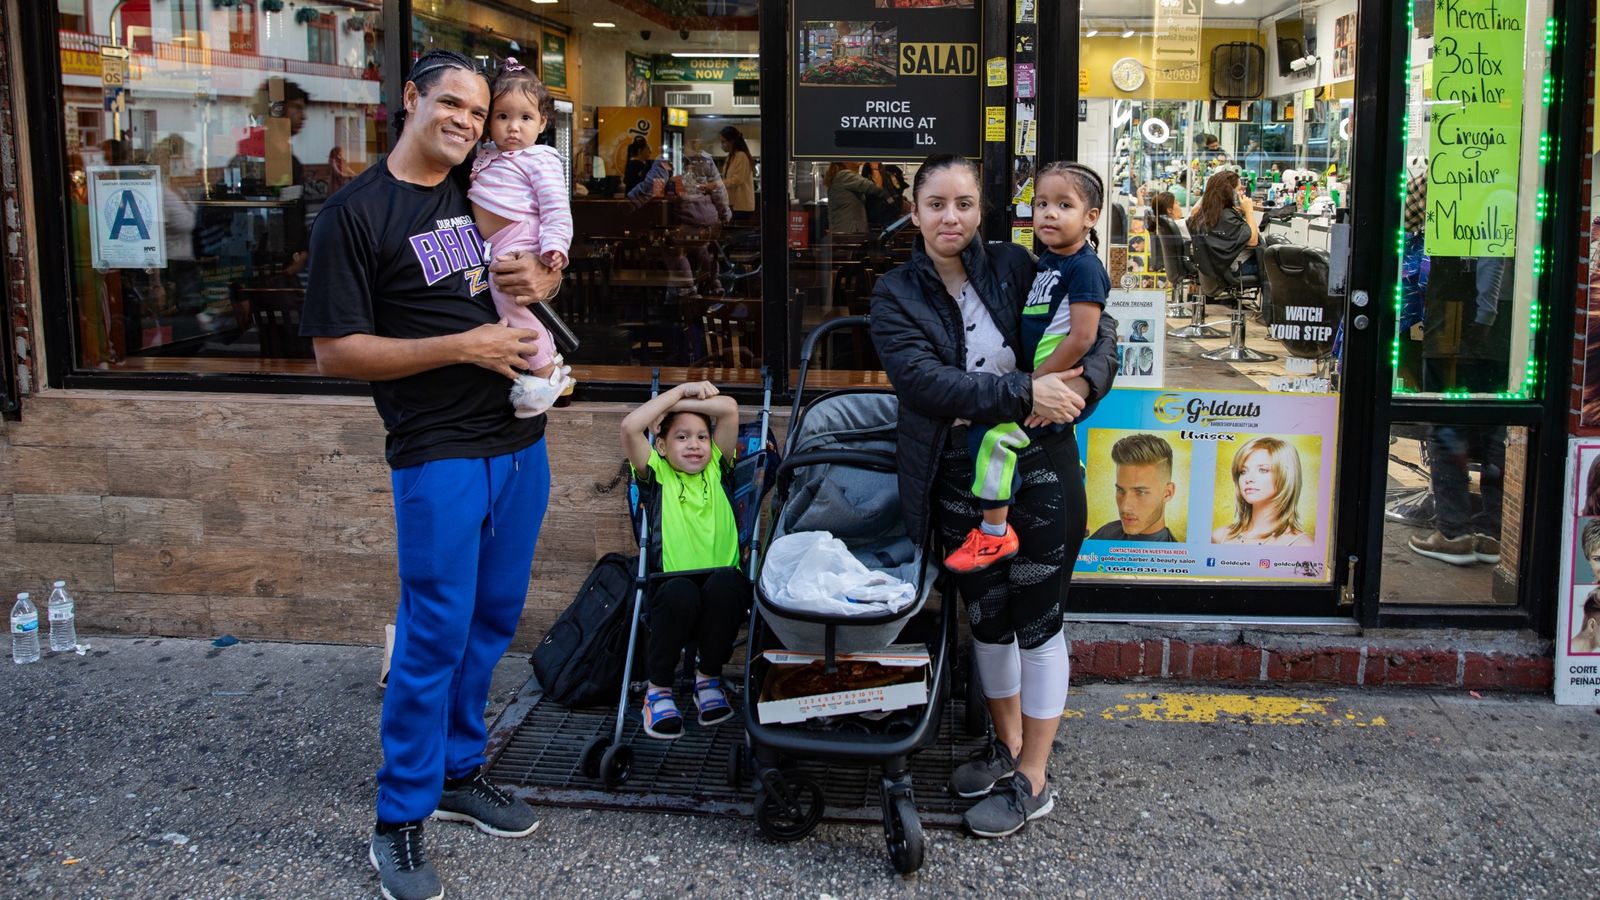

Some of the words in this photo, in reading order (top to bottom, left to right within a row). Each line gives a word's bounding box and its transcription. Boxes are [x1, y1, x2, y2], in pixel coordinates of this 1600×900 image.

[1446, 0, 1522, 31] Keratina
[690, 59, 729, 69] ORDER
[902, 44, 975, 74] SALAD
[1440, 37, 1503, 76] Botox
[695, 70, 724, 79] NOW
[1436, 76, 1504, 113] Capilar
[866, 101, 911, 113] PRICE
[840, 116, 914, 129] STARTING
[917, 116, 937, 129] AT
[916, 133, 937, 145] Lb.
[1431, 152, 1499, 200] Capilar
[109, 190, 151, 240] A
[436, 215, 473, 229] DURANGO
[1285, 305, 1323, 323] WATCH
[1270, 324, 1301, 340] YOUR
[1303, 325, 1333, 342] STEP
[1187, 398, 1261, 424] Goldcuts
[1180, 430, 1235, 441] Unisex
[1106, 566, 1189, 574] 1646-836-1406
[1569, 665, 1598, 674] CORTE
